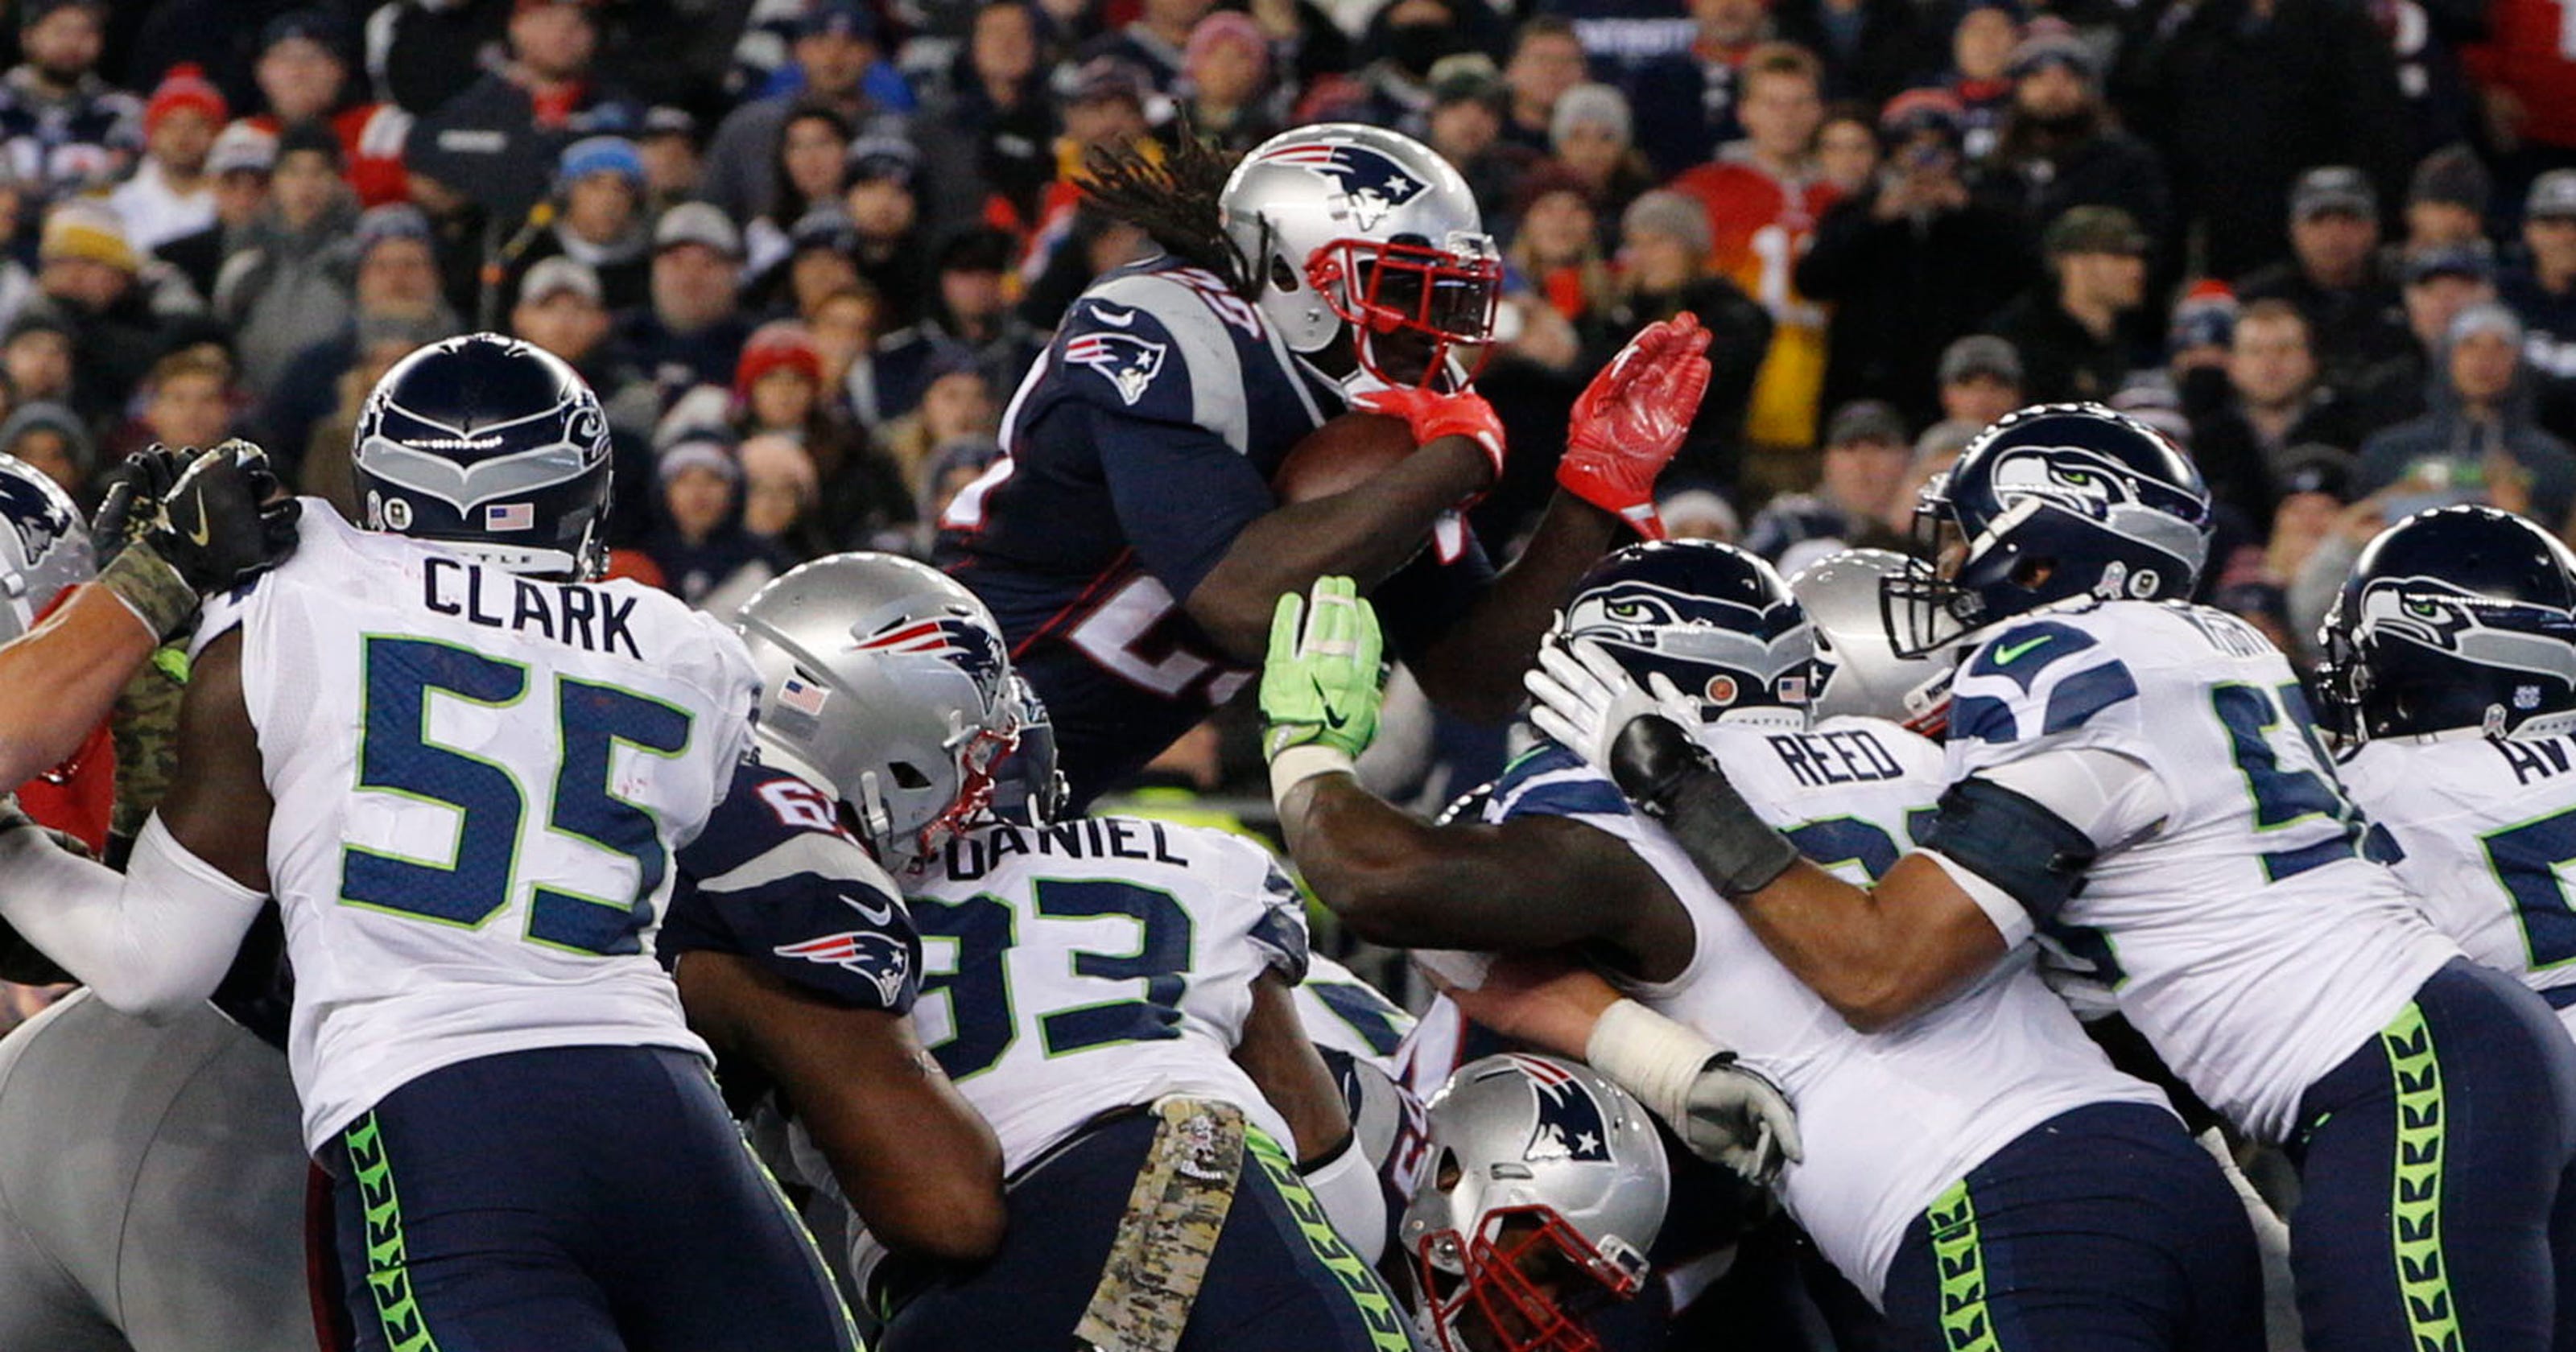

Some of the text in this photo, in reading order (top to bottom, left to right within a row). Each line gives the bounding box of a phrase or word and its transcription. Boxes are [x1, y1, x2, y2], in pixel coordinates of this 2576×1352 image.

[423, 557, 643, 662] CLARK
[338, 632, 696, 956] 55
[1765, 729, 1904, 786] REED
[2484, 731, 2576, 785] AV
